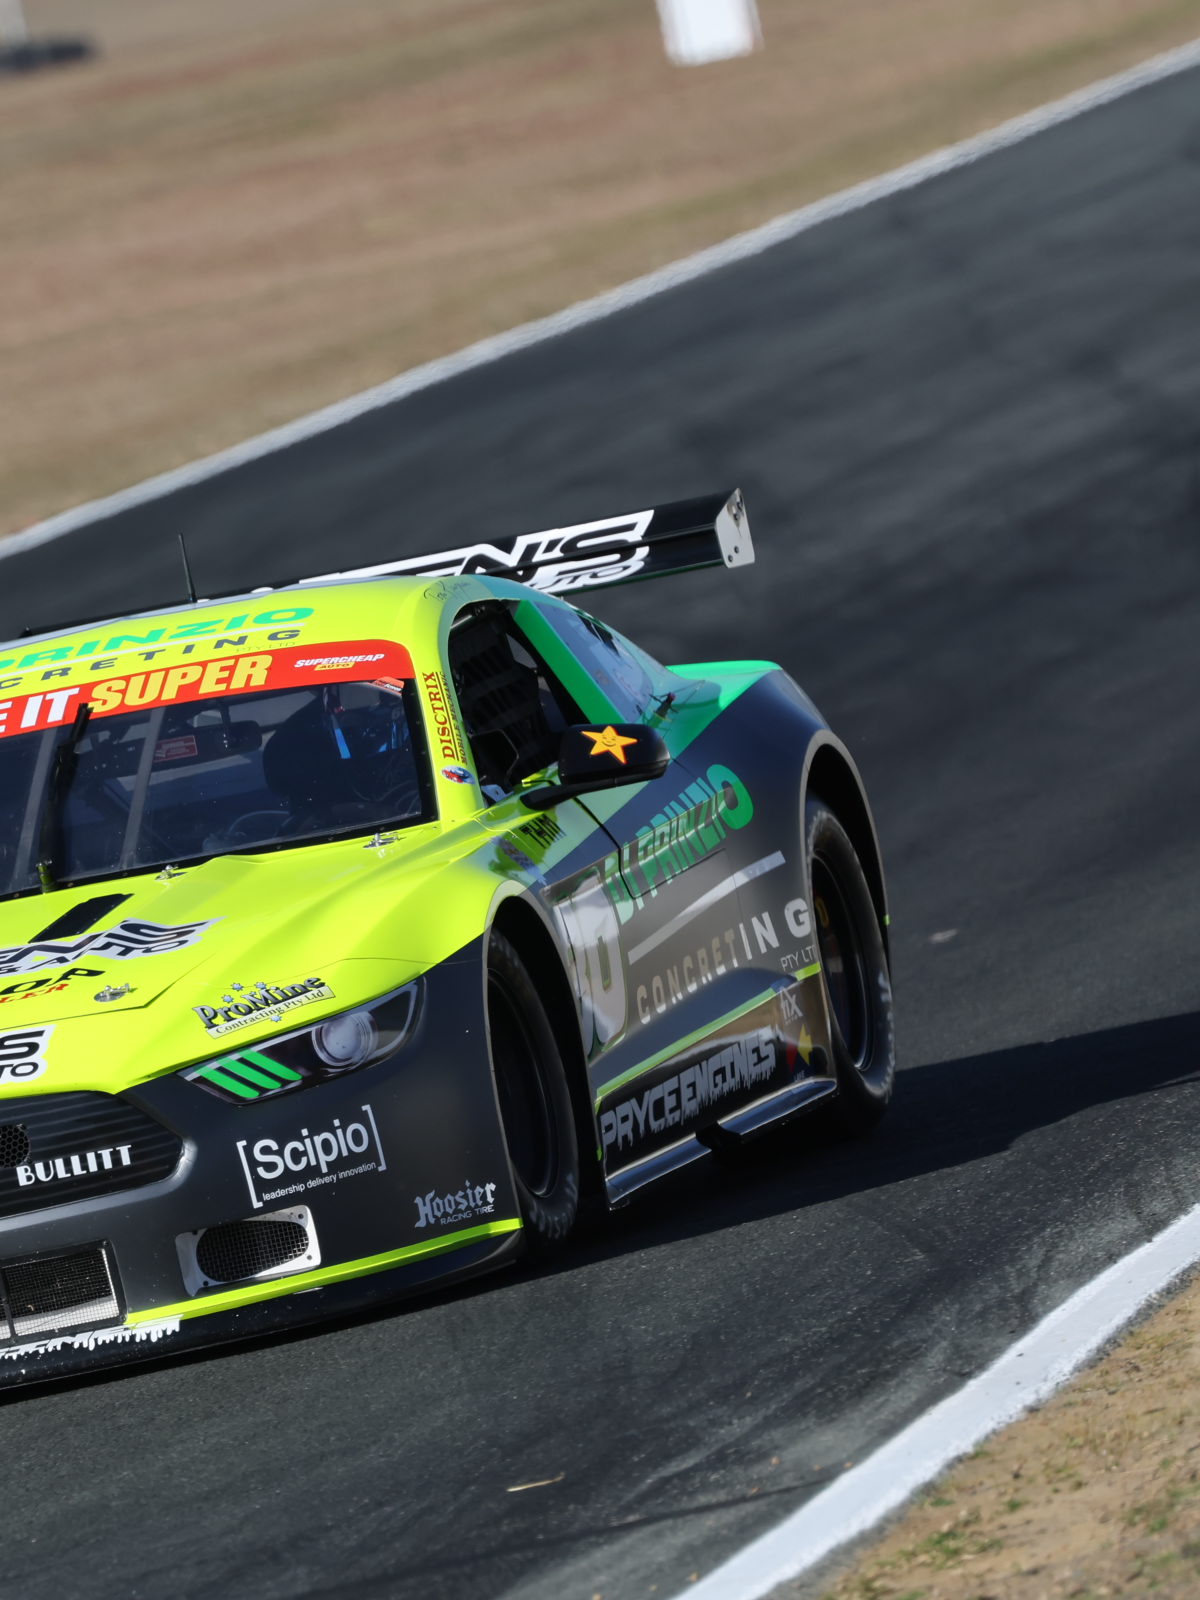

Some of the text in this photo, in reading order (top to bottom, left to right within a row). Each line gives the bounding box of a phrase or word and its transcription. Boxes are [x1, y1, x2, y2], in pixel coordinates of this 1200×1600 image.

[294, 653, 385, 668] SUPERCHEAP
[20, 687, 80, 728] IT
[87, 654, 273, 713] SUPER
[422, 671, 456, 760] DISCTRIX
[637, 897, 812, 1025] CONCRETING
[780, 951, 799, 972] PTY
[192, 976, 326, 1029] ProMine
[215, 989, 325, 1034] Contracting Pty Ltd
[16, 1144, 132, 1186] BULLITT
[262, 1161, 377, 1201] leadership delivery innovation
[414, 1179, 497, 1228] Hoosier
[440, 1204, 495, 1225] RACING TIRE
